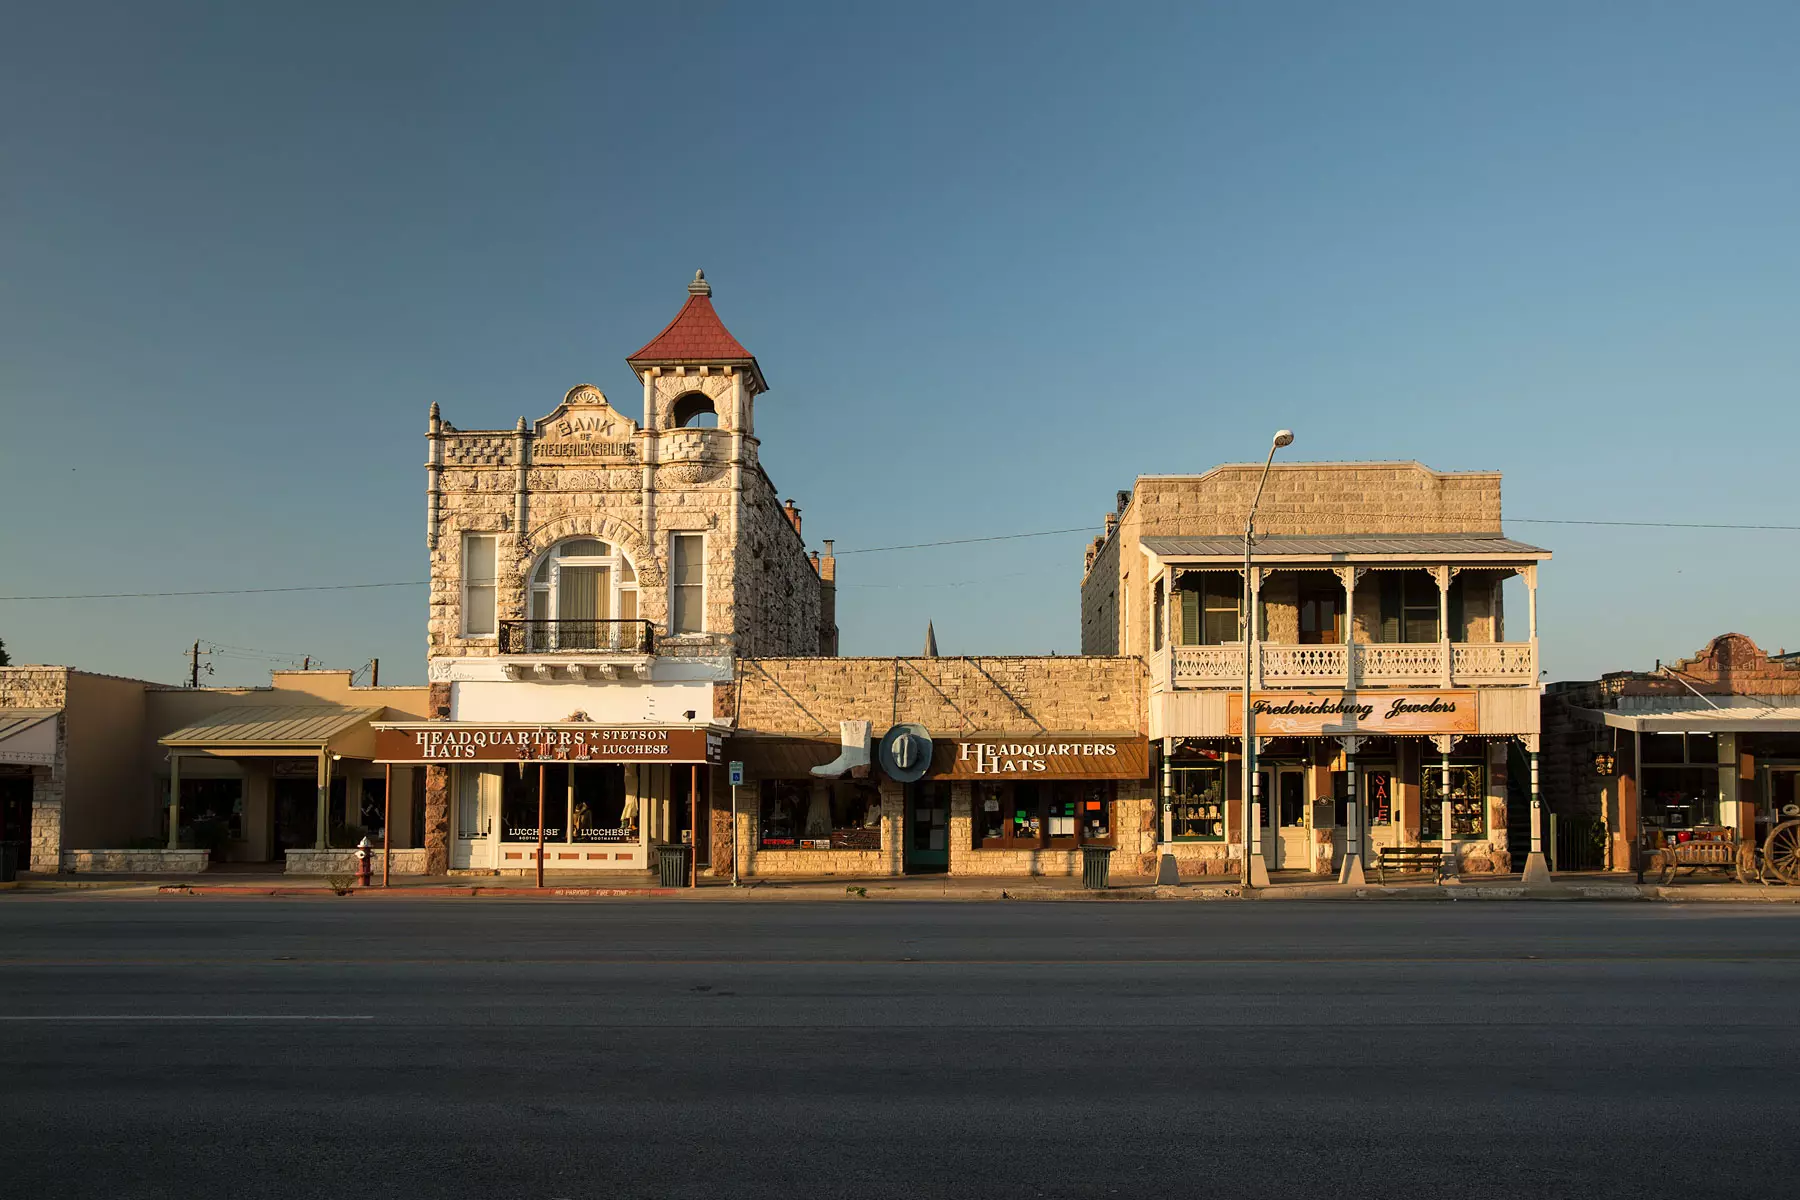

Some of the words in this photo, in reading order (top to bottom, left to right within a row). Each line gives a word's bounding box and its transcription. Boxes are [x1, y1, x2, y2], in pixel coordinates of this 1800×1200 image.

[557, 417, 615, 437] BANK
[580, 433, 592, 441] OF
[533, 442, 637, 457] FREDERICKSBURG
[1712, 660, 1755, 670] JEWELER
[1252, 698, 1374, 721] Fredericksburg
[1385, 697, 1456, 719] Jewelers
[416, 731, 585, 746] HEADQUARTERS
[602, 731, 668, 740] STETSON
[422, 743, 476, 758] HATS
[602, 745, 669, 755] LUCCHESE
[959, 743, 1117, 761] HEADQUARTERS
[974, 756, 1047, 774] HATS
[1375, 775, 1389, 821] SALE
[581, 828, 630, 836] LUCCHESE
